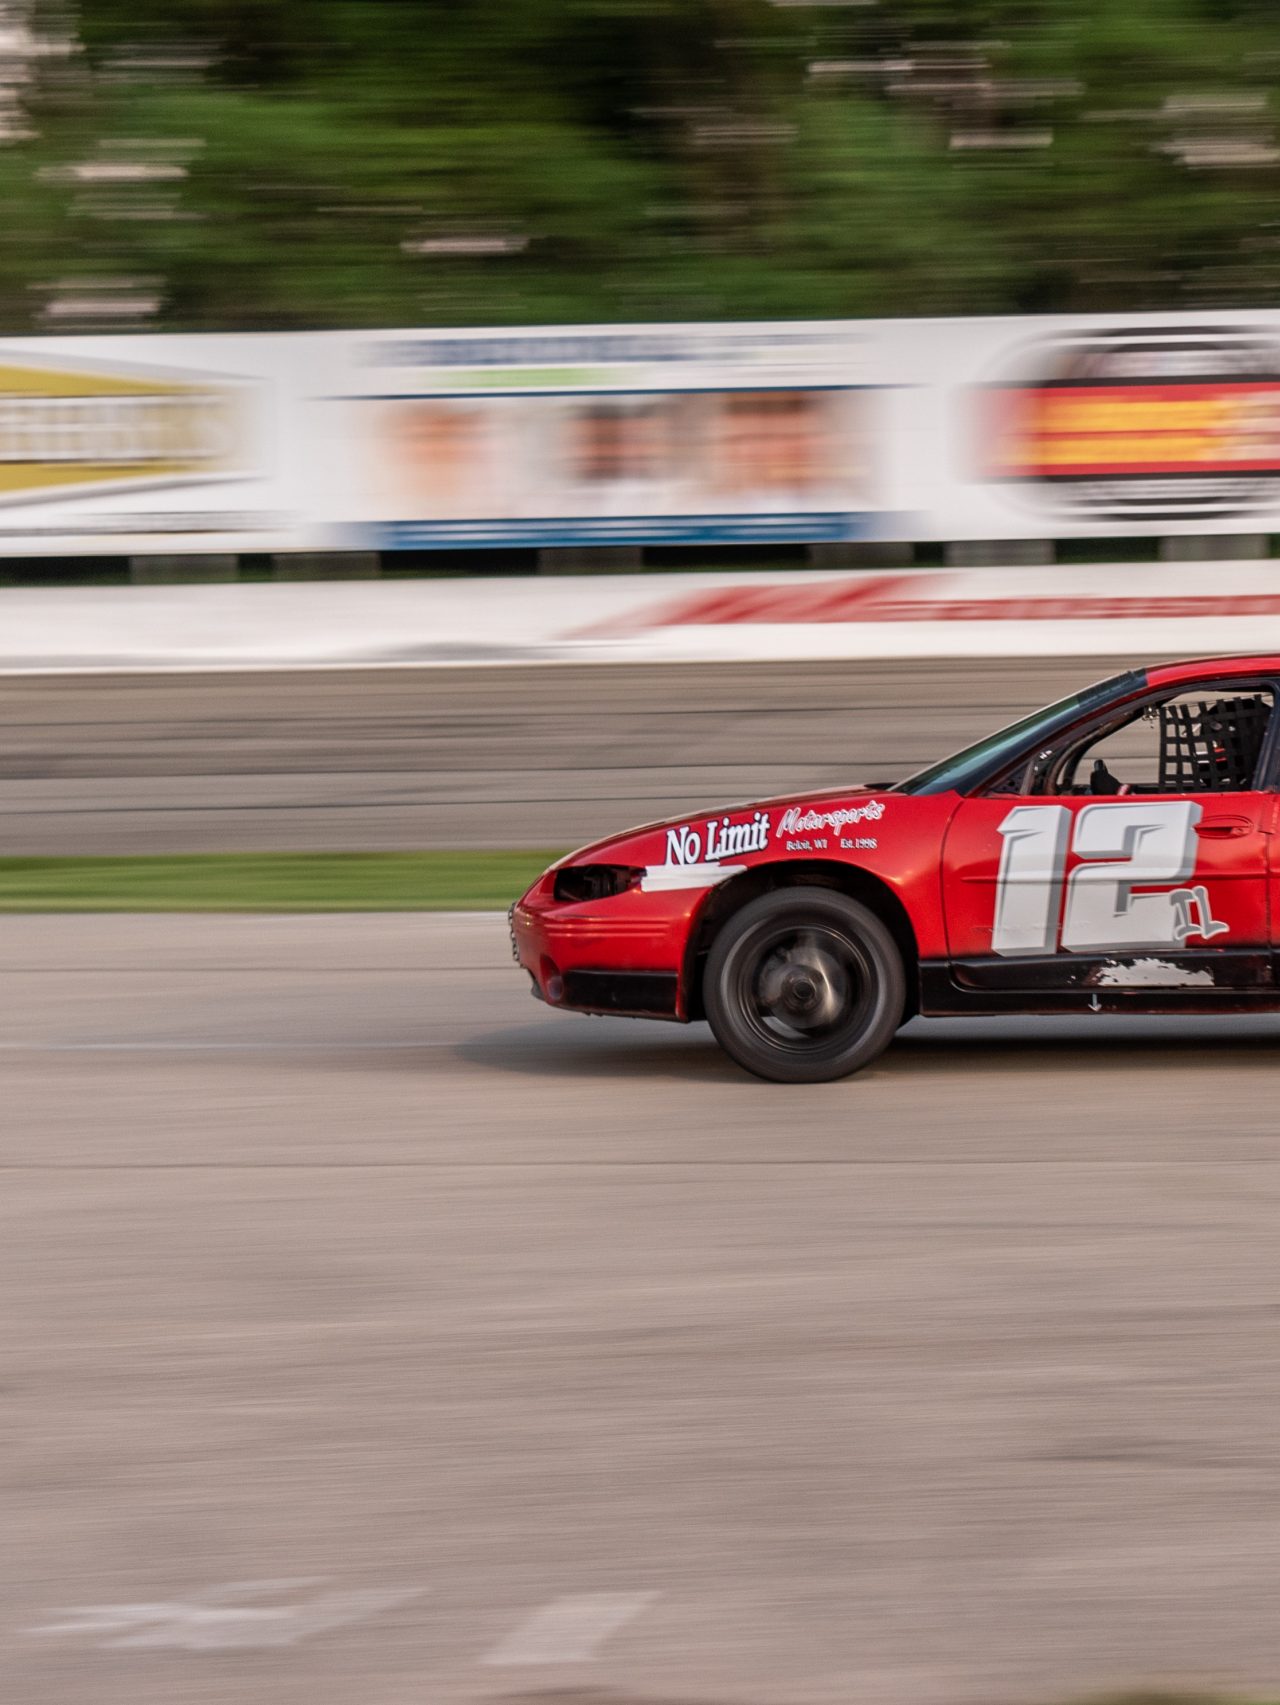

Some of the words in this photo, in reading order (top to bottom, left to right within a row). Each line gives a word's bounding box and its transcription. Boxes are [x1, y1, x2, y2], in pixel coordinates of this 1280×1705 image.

[664, 825, 701, 866] No
[704, 811, 770, 861] Limit
[776, 800, 886, 838] Motorsports
[992, 801, 1203, 957] 12
